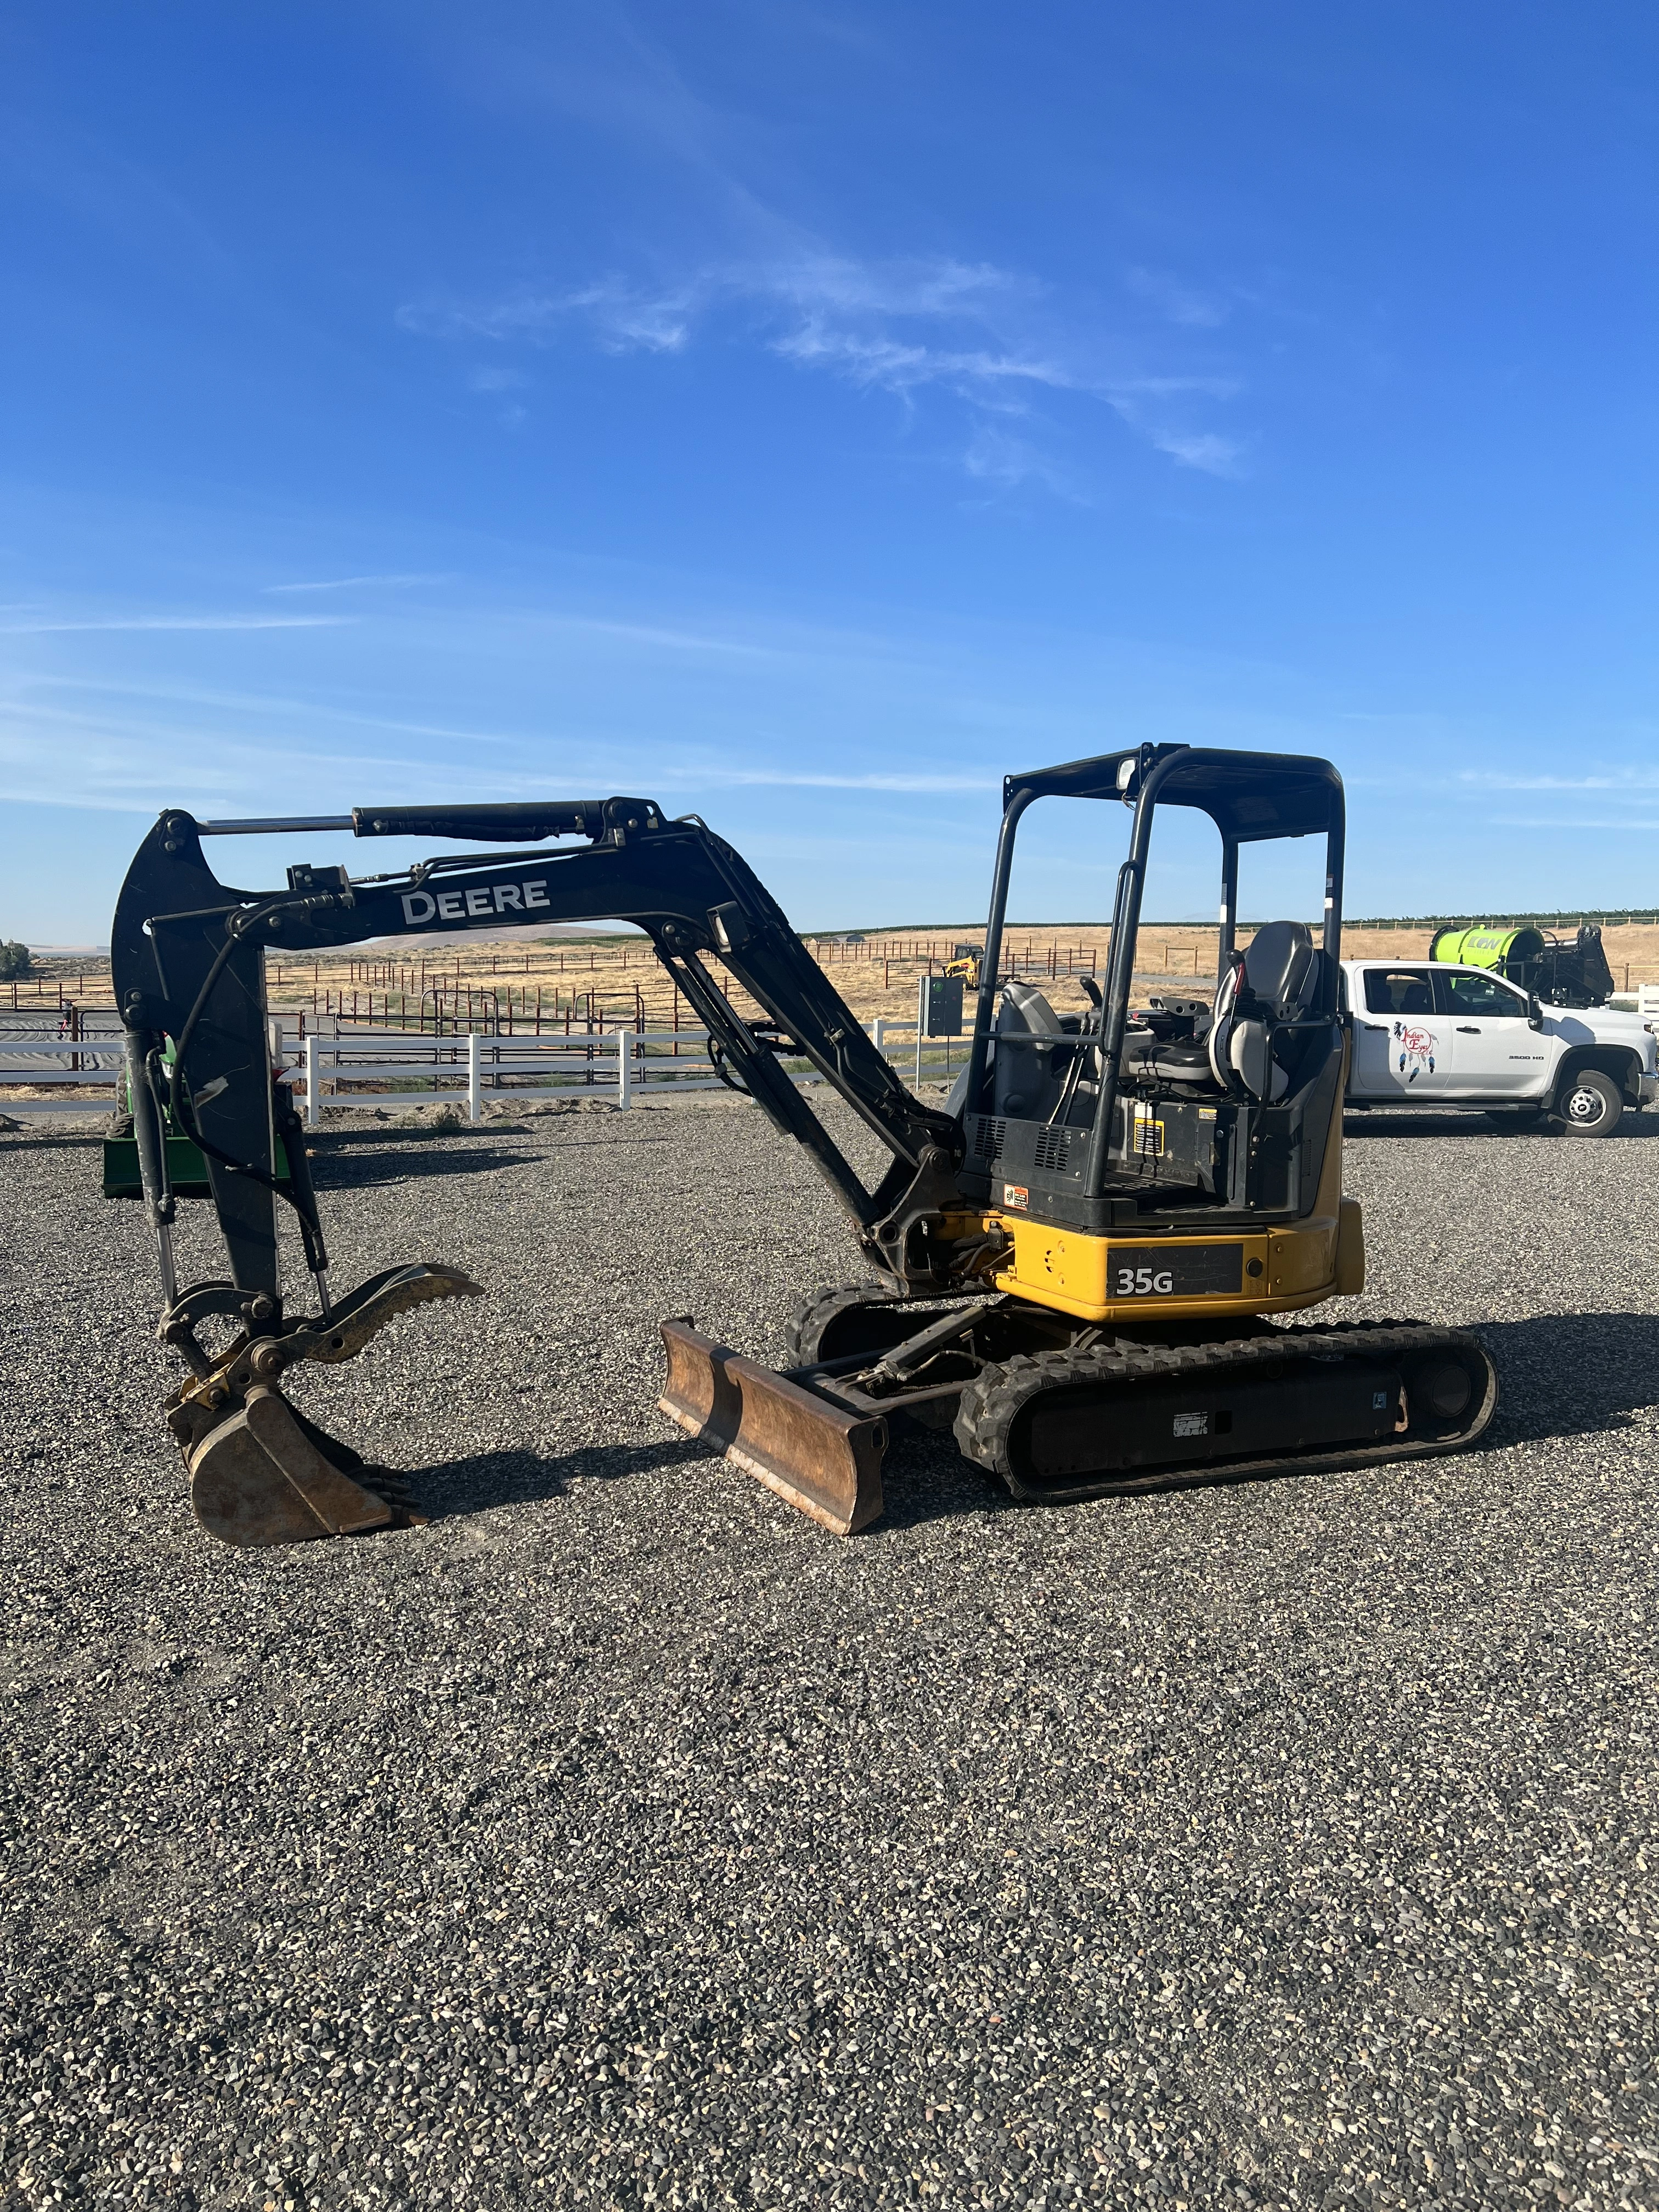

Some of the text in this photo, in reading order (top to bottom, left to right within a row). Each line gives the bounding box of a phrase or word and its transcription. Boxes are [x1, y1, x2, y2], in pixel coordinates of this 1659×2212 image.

[401, 880, 551, 924] DEERE
[1401, 1029, 1424, 1042] Indian
[1116, 1268, 1173, 1295] 35G
